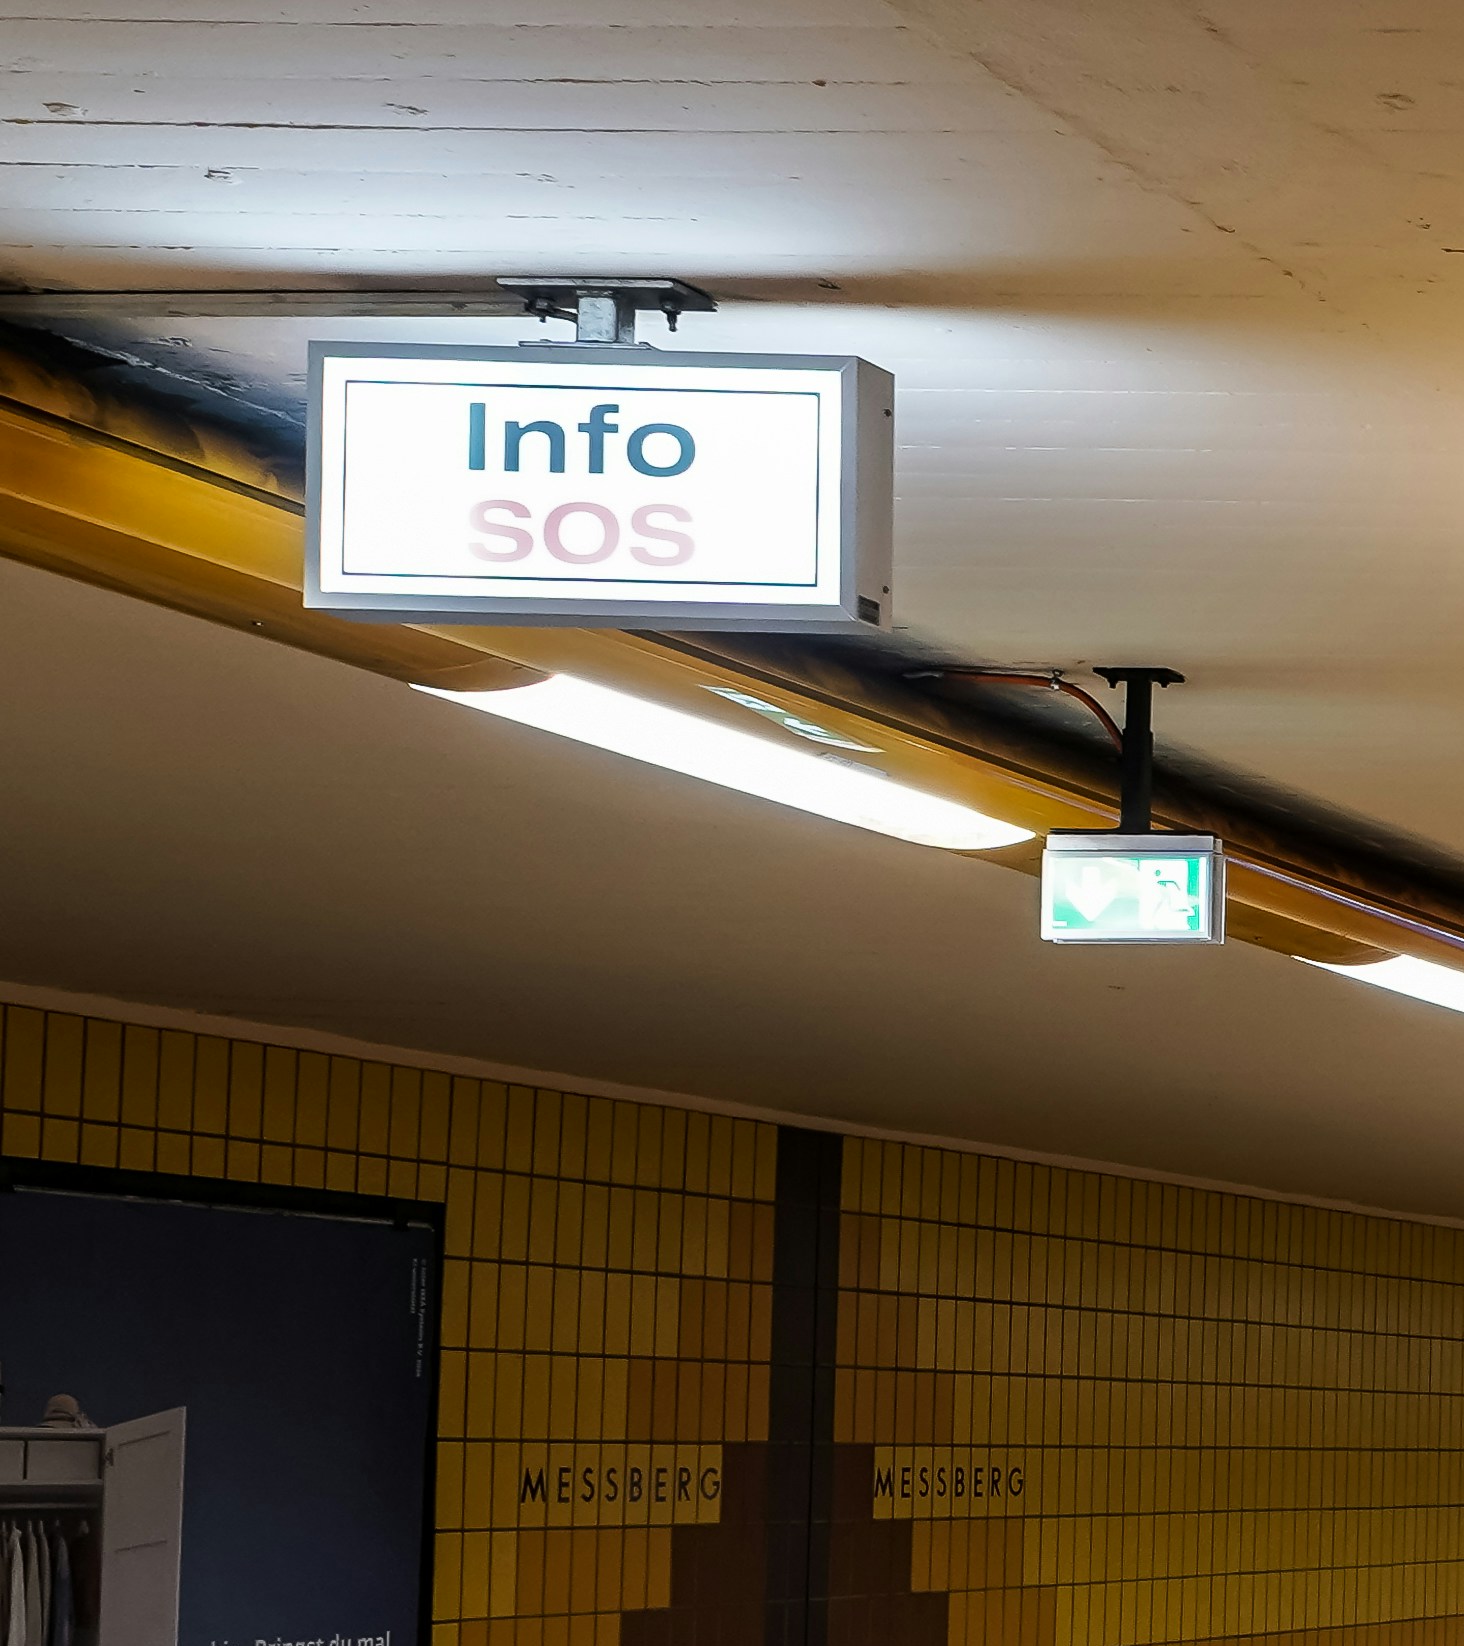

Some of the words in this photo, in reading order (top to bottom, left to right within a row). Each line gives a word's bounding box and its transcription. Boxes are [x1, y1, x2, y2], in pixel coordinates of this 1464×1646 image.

[468, 401, 697, 478] Info
[468, 499, 697, 568] SOS
[519, 1466, 721, 1504] MESSBERG
[873, 1465, 1026, 1500] MESSBERG
